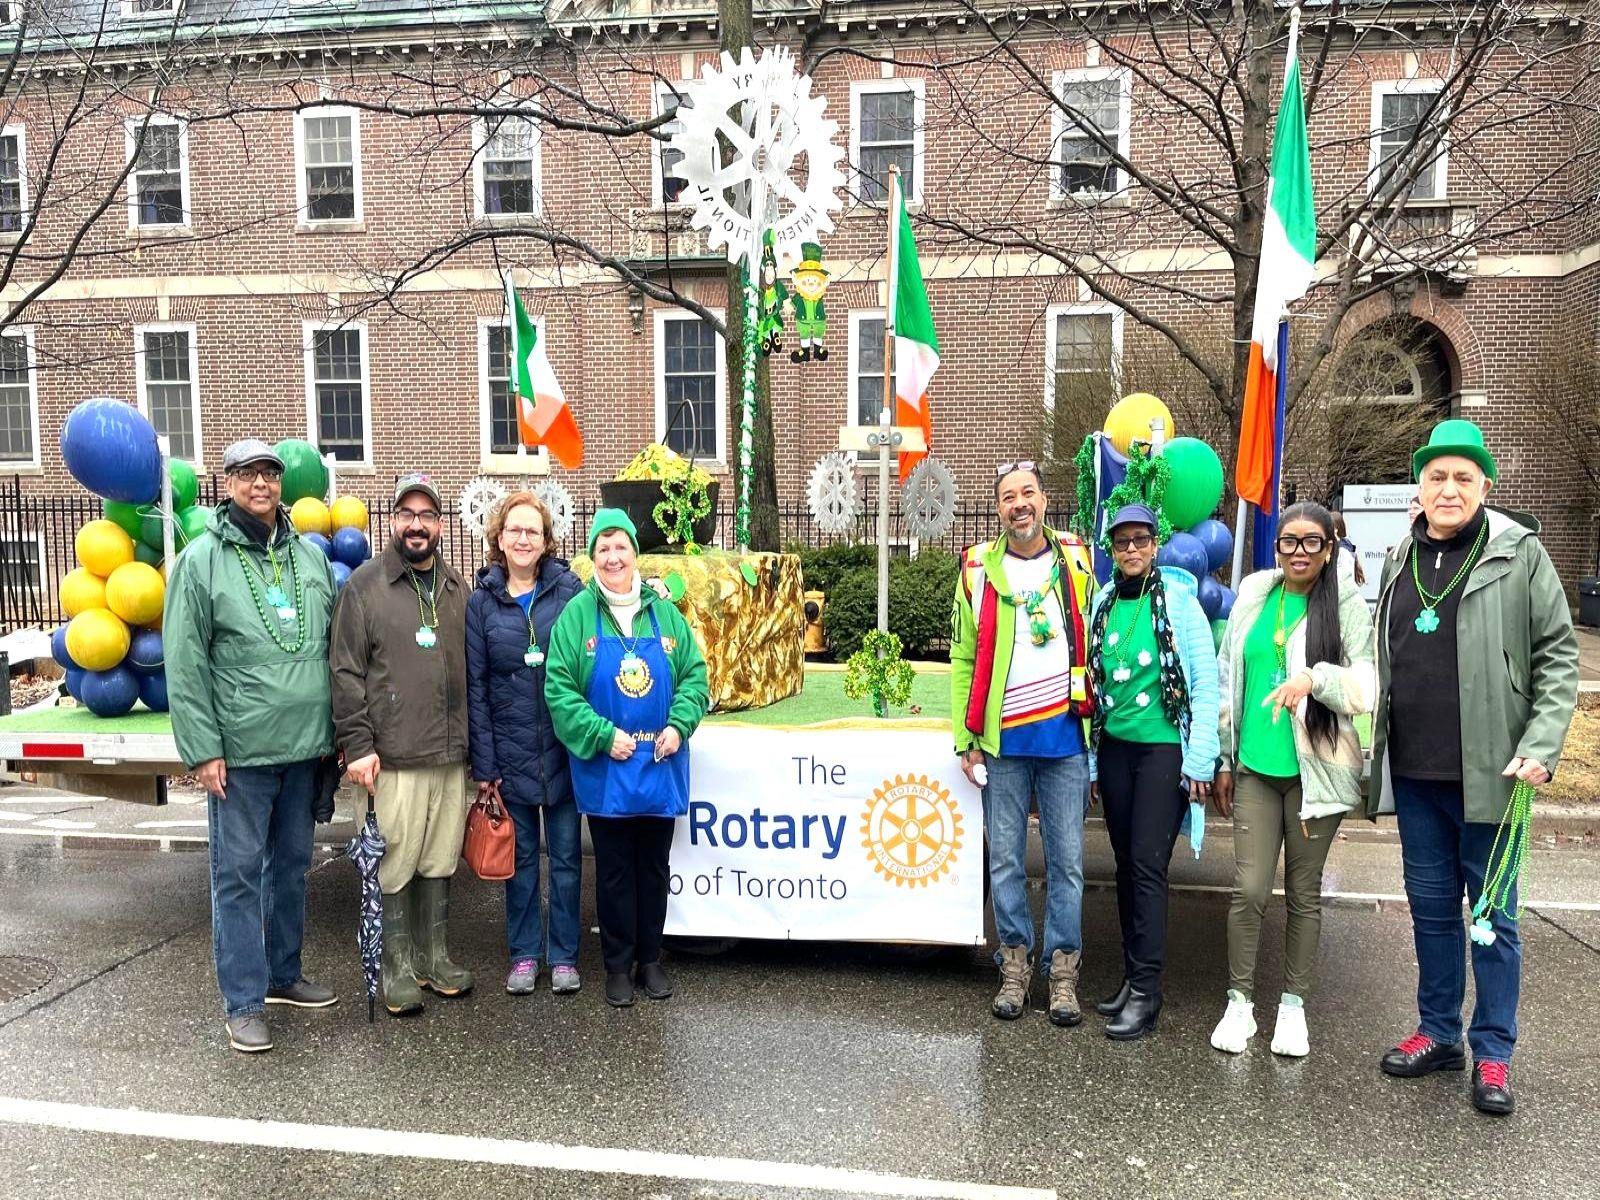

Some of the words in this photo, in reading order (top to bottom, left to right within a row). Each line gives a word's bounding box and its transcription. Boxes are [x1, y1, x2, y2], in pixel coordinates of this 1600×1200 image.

[1374, 497, 1410, 505] TORONT
[1364, 551, 1386, 559] Whitn
[792, 755, 846, 785] The
[889, 786, 932, 799] ROTARY
[689, 801, 847, 860] Rotary
[877, 849, 947, 876] INTERNATIONAL
[694, 866, 723, 896] of
[730, 869, 847, 900] Toronto
